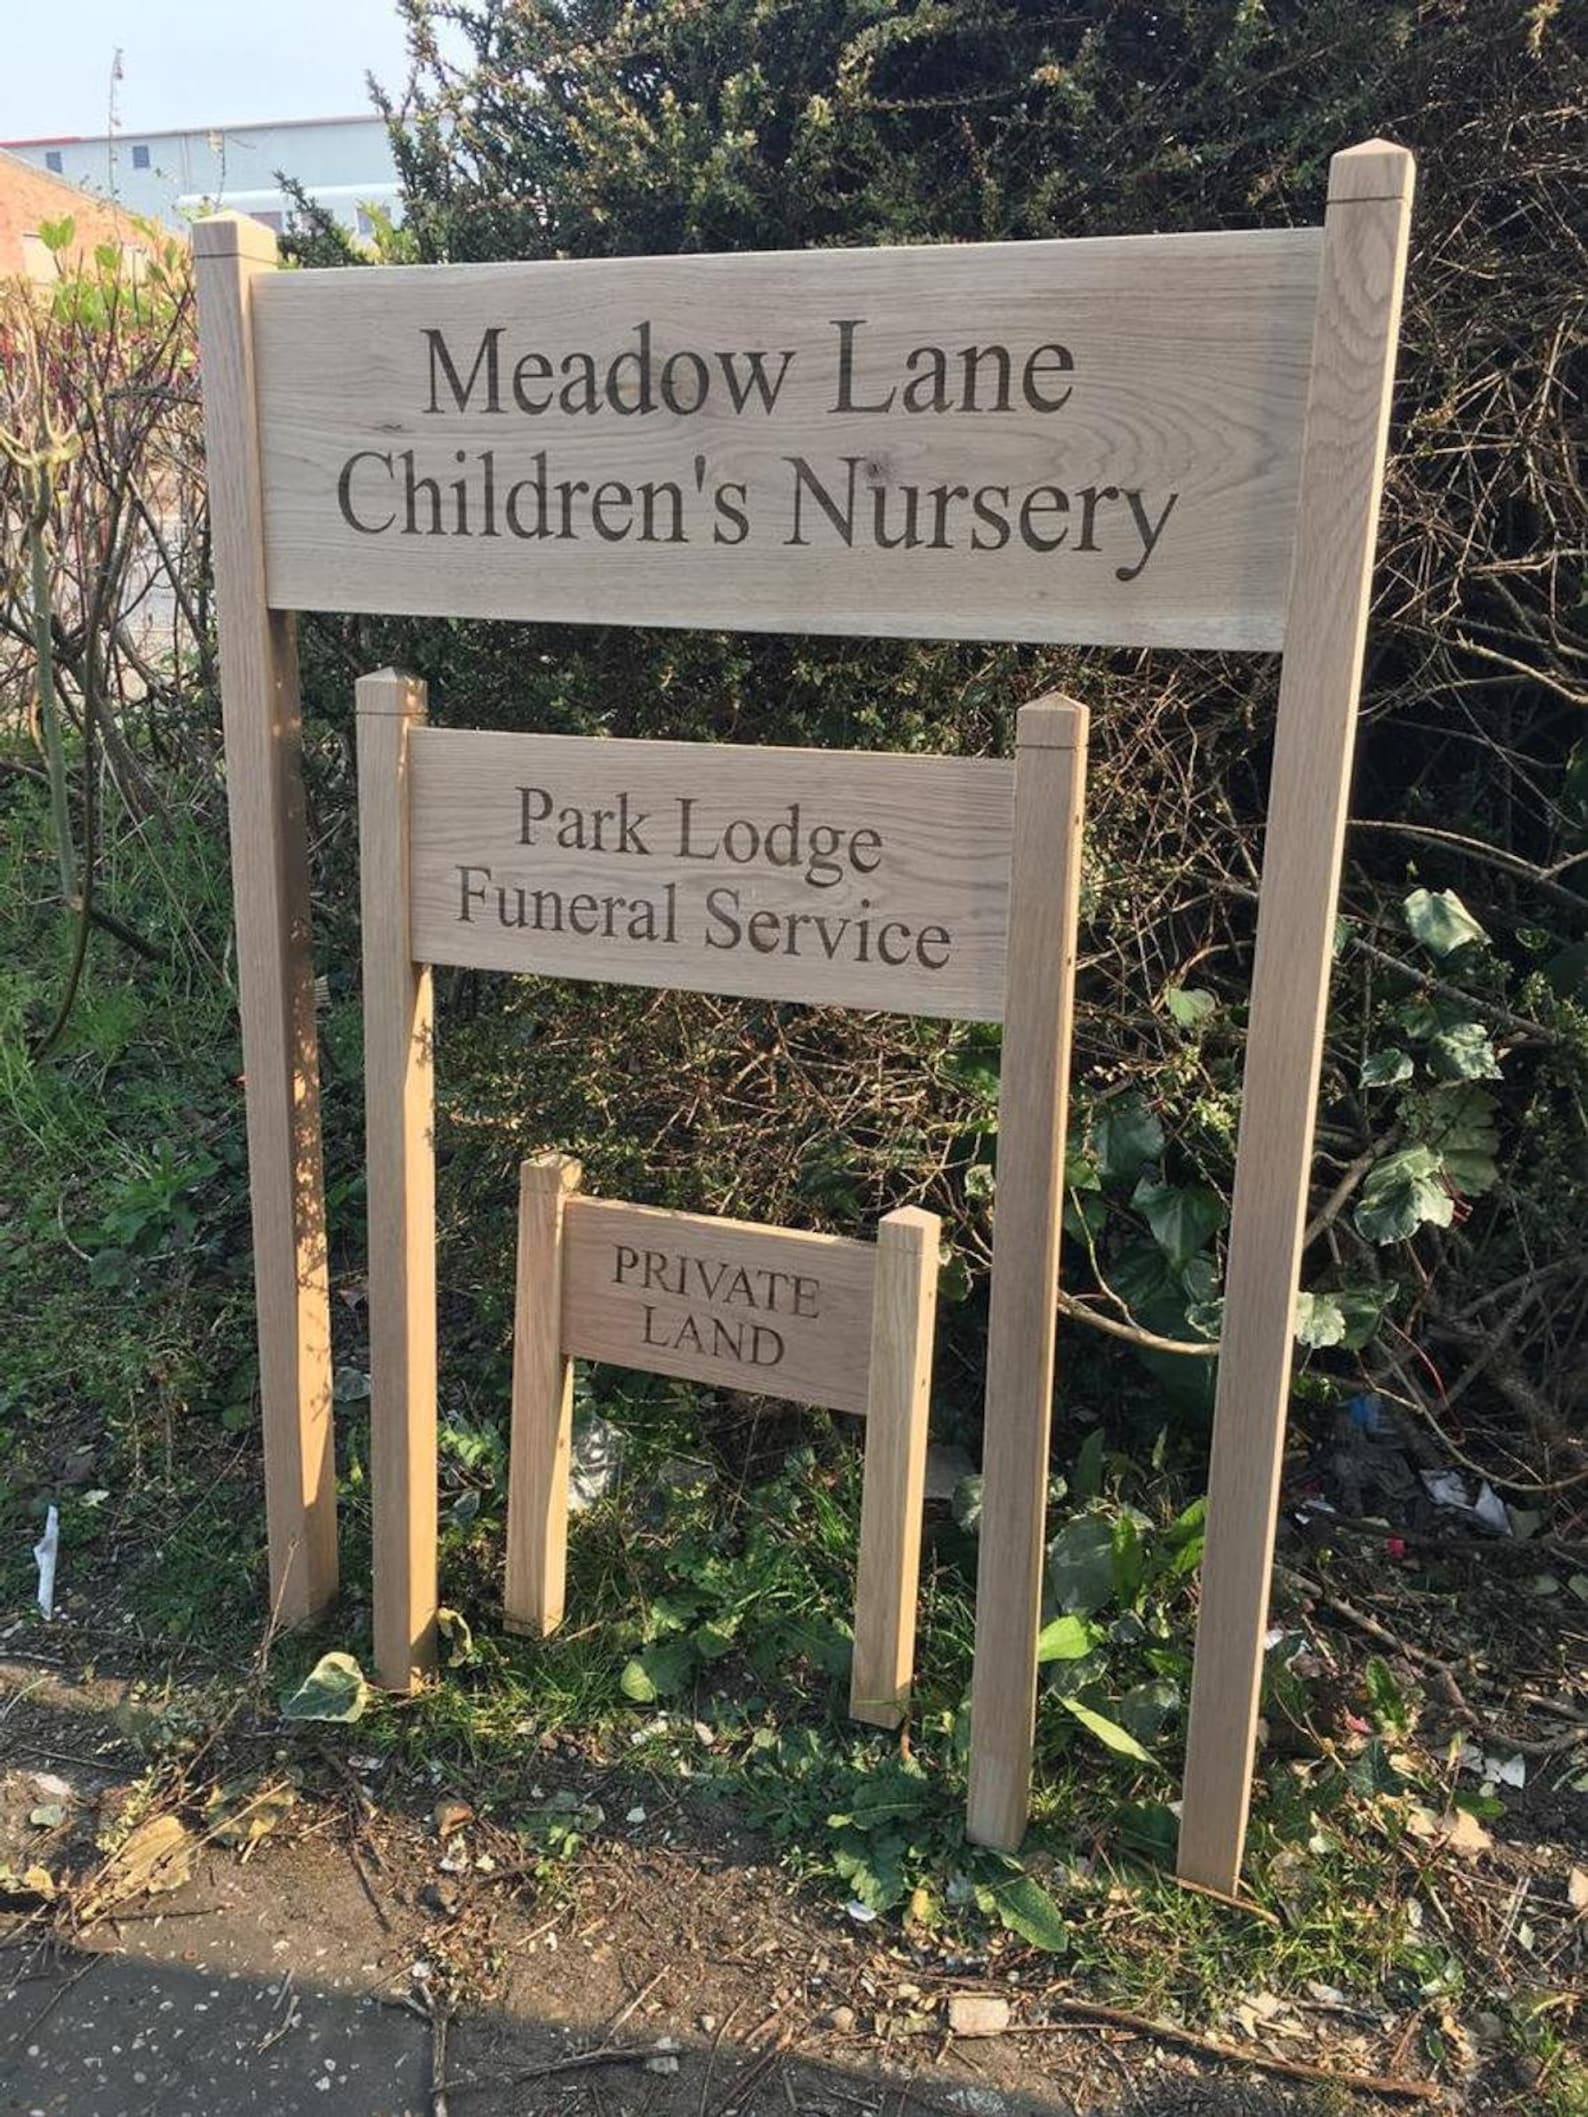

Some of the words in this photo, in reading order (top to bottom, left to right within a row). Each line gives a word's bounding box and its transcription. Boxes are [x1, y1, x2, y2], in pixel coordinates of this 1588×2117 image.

[420, 320, 795, 417] Meadow
[827, 319, 1075, 414] Lane
[337, 450, 750, 545] Children's
[782, 455, 1179, 583] Nursery
[515, 786, 652, 856] Park
[674, 797, 884, 888] Lodge
[455, 864, 680, 944] Funeral
[705, 887, 952, 970] Service
[611, 1244, 821, 1319] PRIVATE
[640, 1304, 785, 1367] LAND
